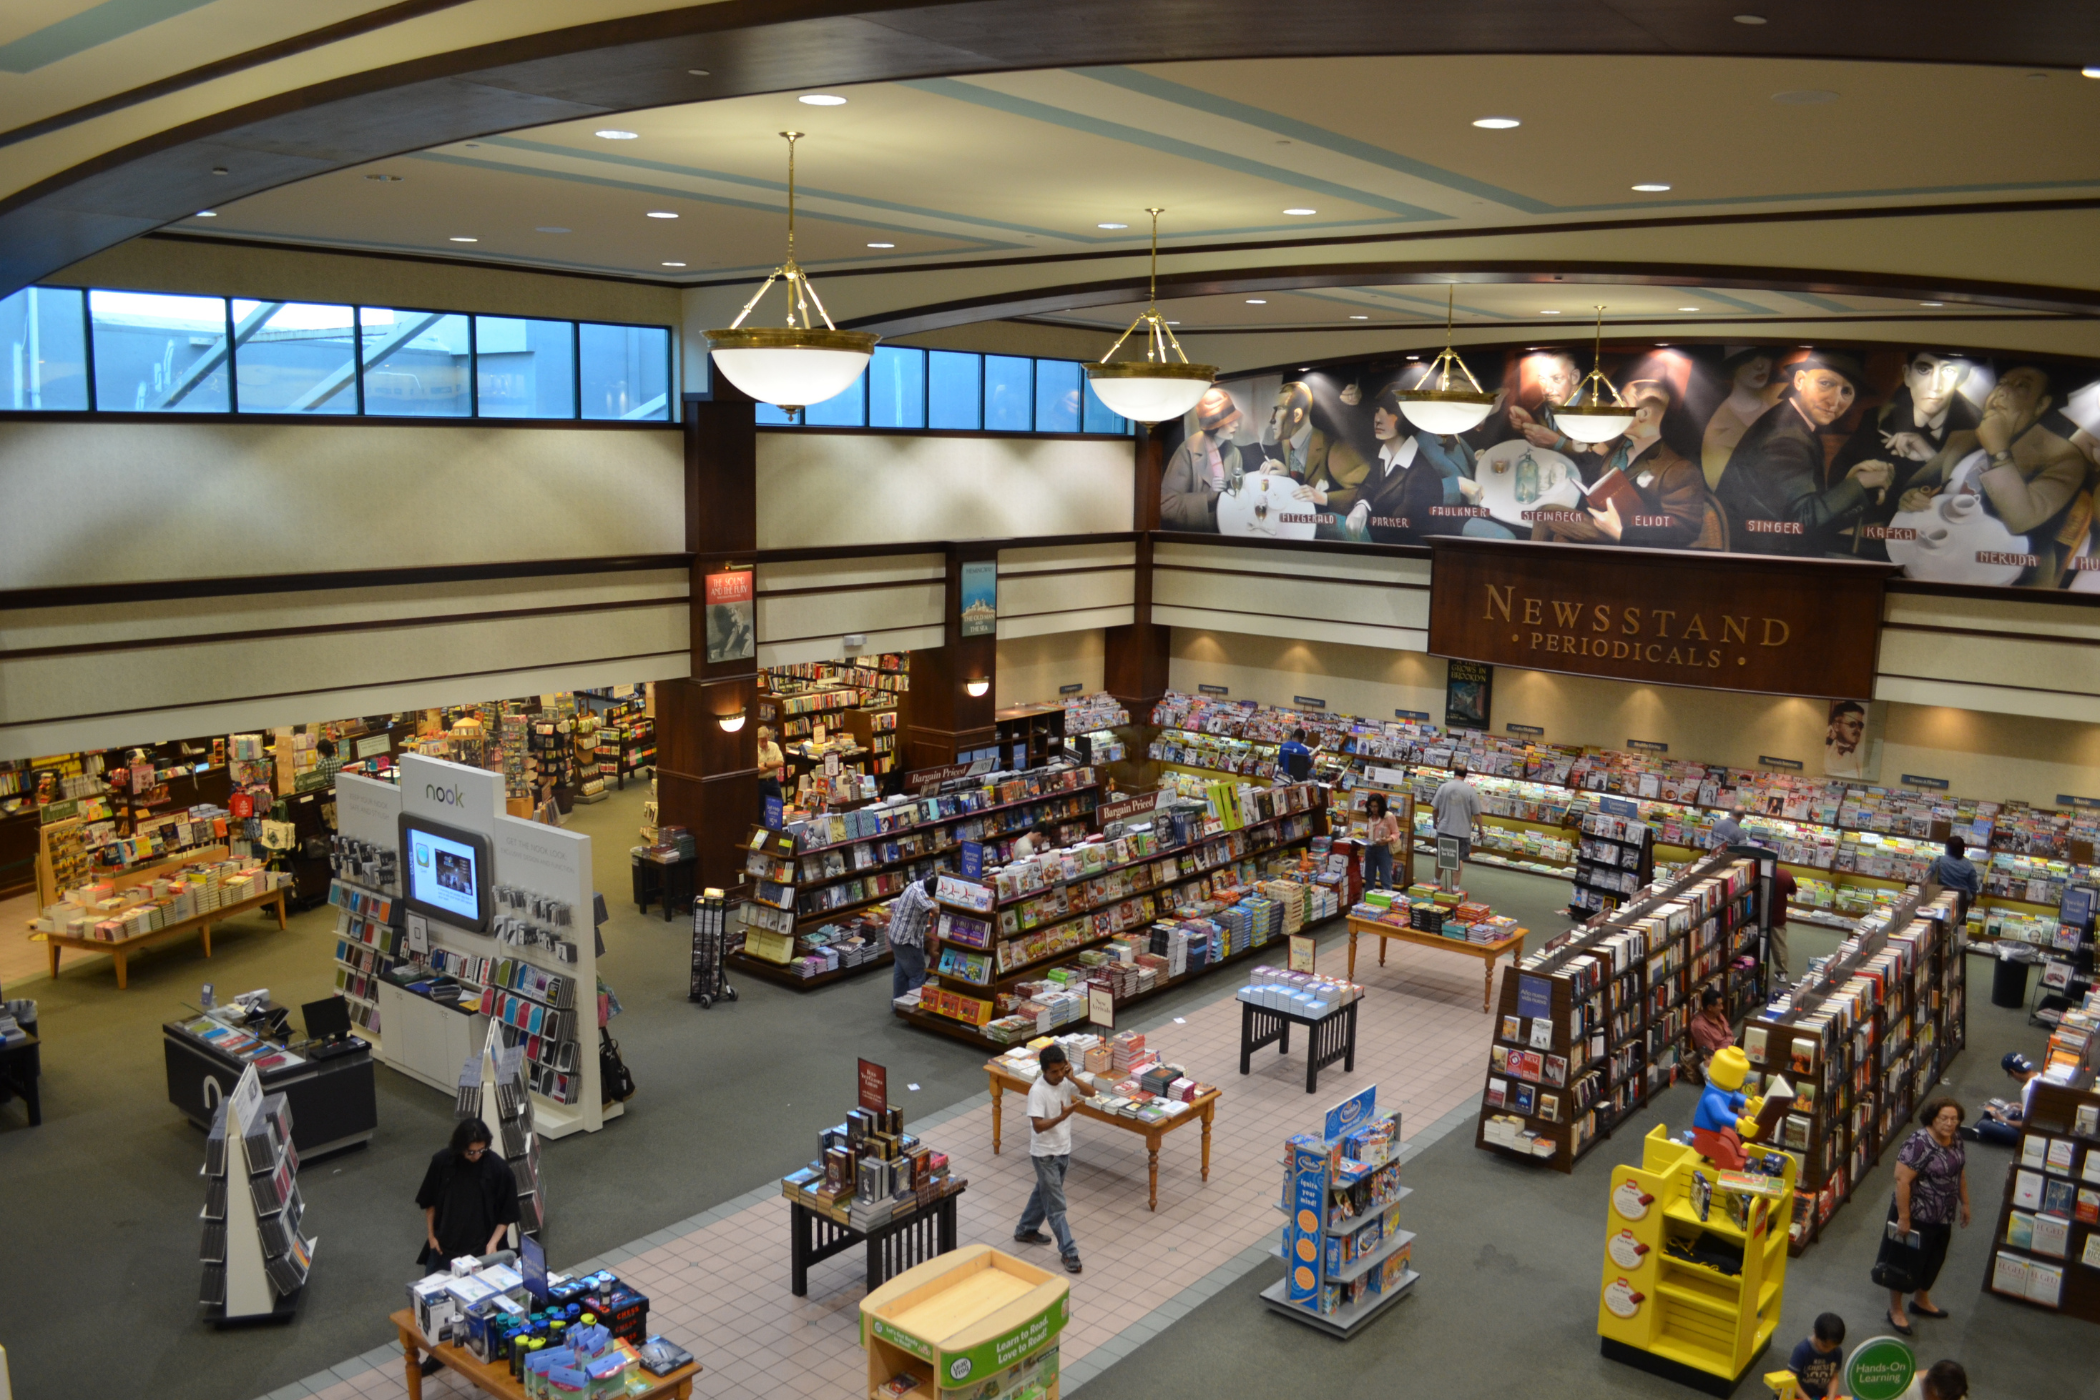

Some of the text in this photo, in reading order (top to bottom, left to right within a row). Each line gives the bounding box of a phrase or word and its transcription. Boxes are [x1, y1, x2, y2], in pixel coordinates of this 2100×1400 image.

[1432, 506, 1487, 518] FAULKNER
[1522, 511, 1583, 523] STEINBECK
[1282, 513, 1334, 525] FITZGERALD
[1372, 516, 1409, 528] PARKER
[1635, 515, 1670, 527] ELIOT
[1746, 519, 1802, 534] SINGER
[1866, 526, 1914, 540] KAFKA
[1980, 551, 2037, 567] NERUDA
[713, 576, 745, 588] THE SOUND
[711, 584, 748, 596] AND THE FURY
[974, 614, 983, 622] OLD
[1483, 583, 1790, 647] NEWSSTAND
[1530, 632, 1721, 668] PERIODICALS
[1451, 664, 1477, 674] GROWS
[1451, 672, 1487, 682] BROOKLYN
[911, 770, 941, 784] Bargain
[942, 765, 967, 778] Priced
[426, 783, 464, 808] nook
[2073, 797, 2090, 805] Music
[1103, 796, 1154, 818] Bargain Priced
[530, 844, 548, 855] NOOK
[2064, 898, 2085, 910] Special
[1095, 997, 1106, 1006] New
[1092, 1003, 1111, 1014] Arrivals
[1300, 1178, 1318, 1190] ignite
[1302, 1188, 1315, 1198] your
[1300, 1197, 1317, 1208] mind!
[2035, 1223, 2065, 1236] EL GED
[2007, 1263, 2025, 1276] GED
[2030, 1271, 2058, 1284] EL GED
[616, 1305, 640, 1320] CHESS
[615, 1319, 637, 1333] CHESS
[996, 1334, 1020, 1353] Learn
[1020, 1330, 1029, 1340] to
[998, 1327, 1048, 1364] Love to Read!
[952, 1360, 968, 1372] Leap
[954, 1364, 970, 1378] Frog
[1856, 1362, 1906, 1374] Hands-On
[1859, 1373, 1901, 1384] Learning
